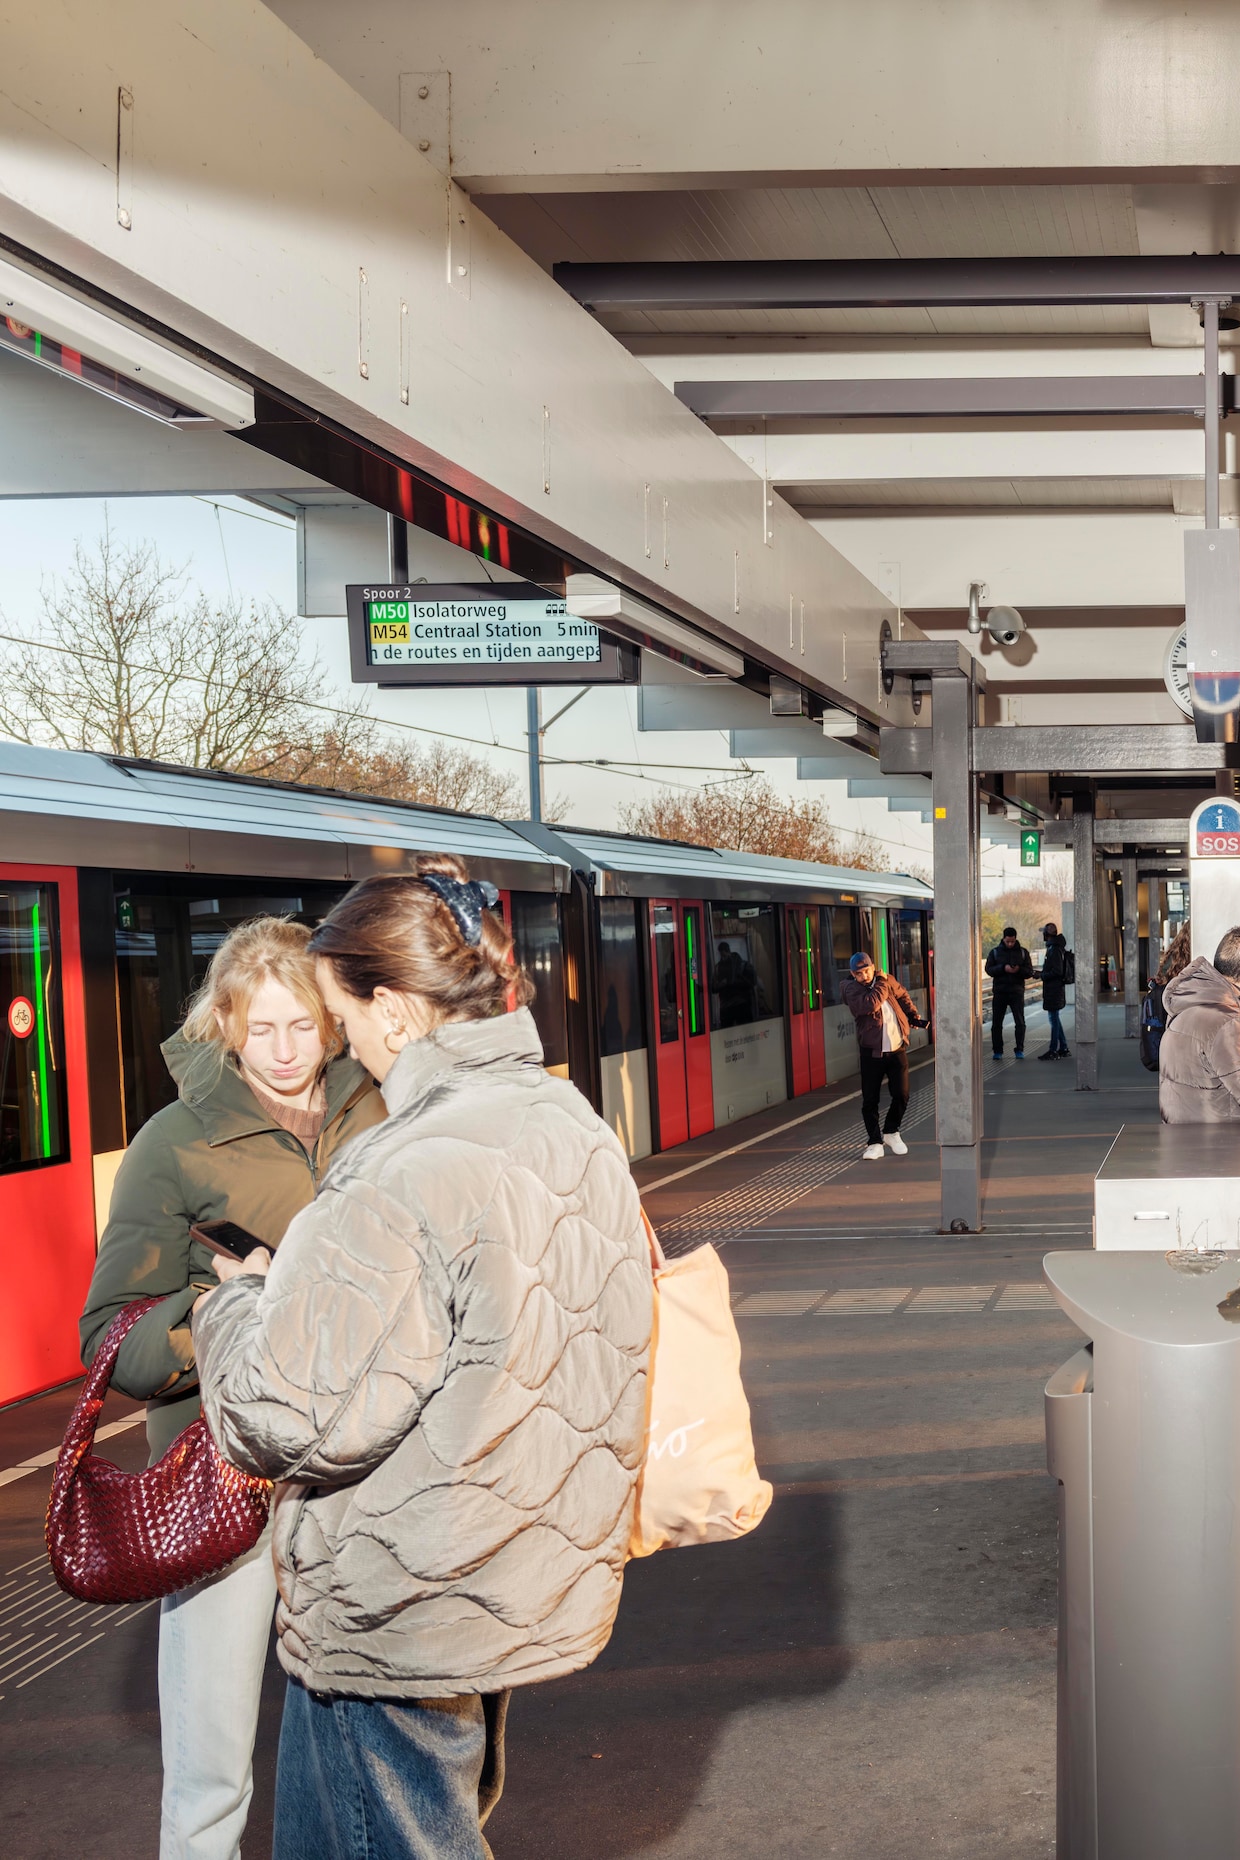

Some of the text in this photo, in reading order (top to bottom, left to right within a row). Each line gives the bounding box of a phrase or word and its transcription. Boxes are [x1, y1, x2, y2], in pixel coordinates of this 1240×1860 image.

[363, 587, 412, 602] Spoor 2
[372, 602, 506, 621] M50 Isolatorweg
[373, 624, 408, 639] M54
[414, 622, 480, 638] Centraal
[485, 622, 542, 638] Station
[384, 644, 402, 660] de
[408, 645, 457, 659] routes
[462, 647, 481, 658] en
[486, 642, 532, 662] tijden
[1202, 837, 1239, 852] SOS
